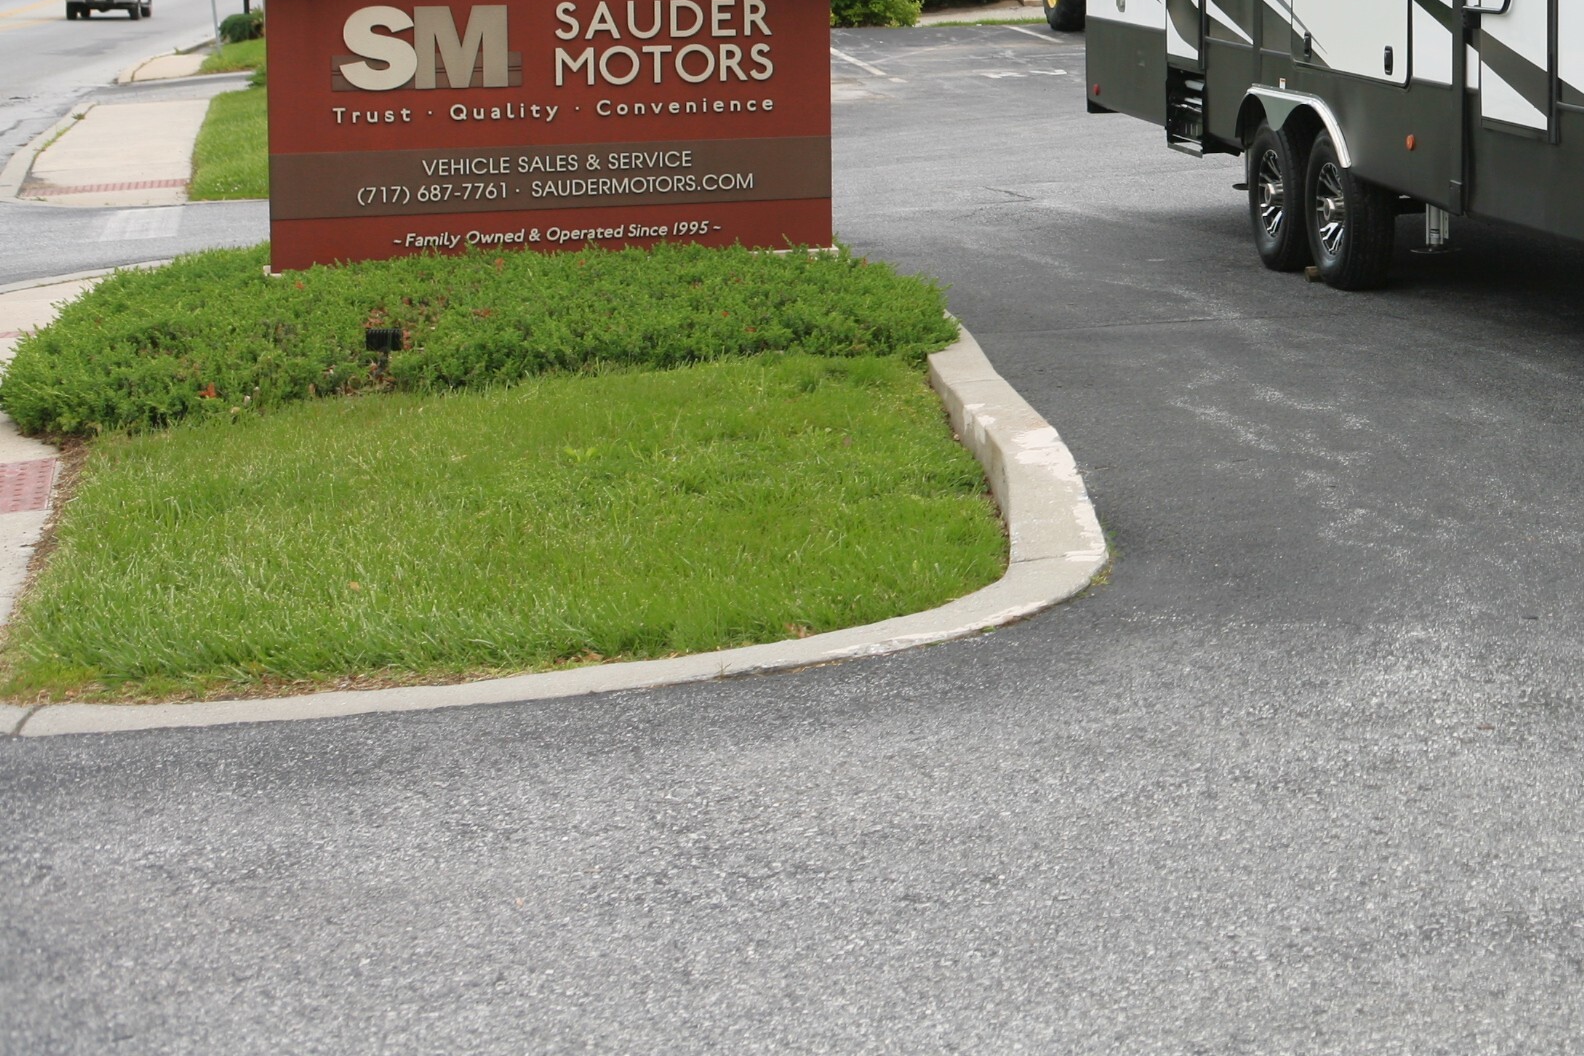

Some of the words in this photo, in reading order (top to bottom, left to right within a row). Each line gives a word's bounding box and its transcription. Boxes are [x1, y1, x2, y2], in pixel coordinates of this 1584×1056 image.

[339, 4, 509, 91] SM
[555, 43, 774, 87] MOTORS
[332, 107, 411, 124] Trust
[450, 102, 559, 122] Quality
[596, 98, 775, 116] Convenience
[422, 156, 511, 176] VEHICLE
[517, 155, 579, 173] SALES
[586, 154, 601, 170] &
[608, 150, 693, 170] SERVICE
[357, 186, 411, 206] (717)
[417, 182, 507, 202] 687-7761
[531, 173, 754, 197] SAUDERMOTORS.COM
[405, 231, 461, 248] Family
[466, 228, 525, 244] Owned
[528, 228, 542, 242] &
[546, 224, 625, 244] Operated
[627, 223, 669, 238] Since
[672, 220, 710, 236] 1995
